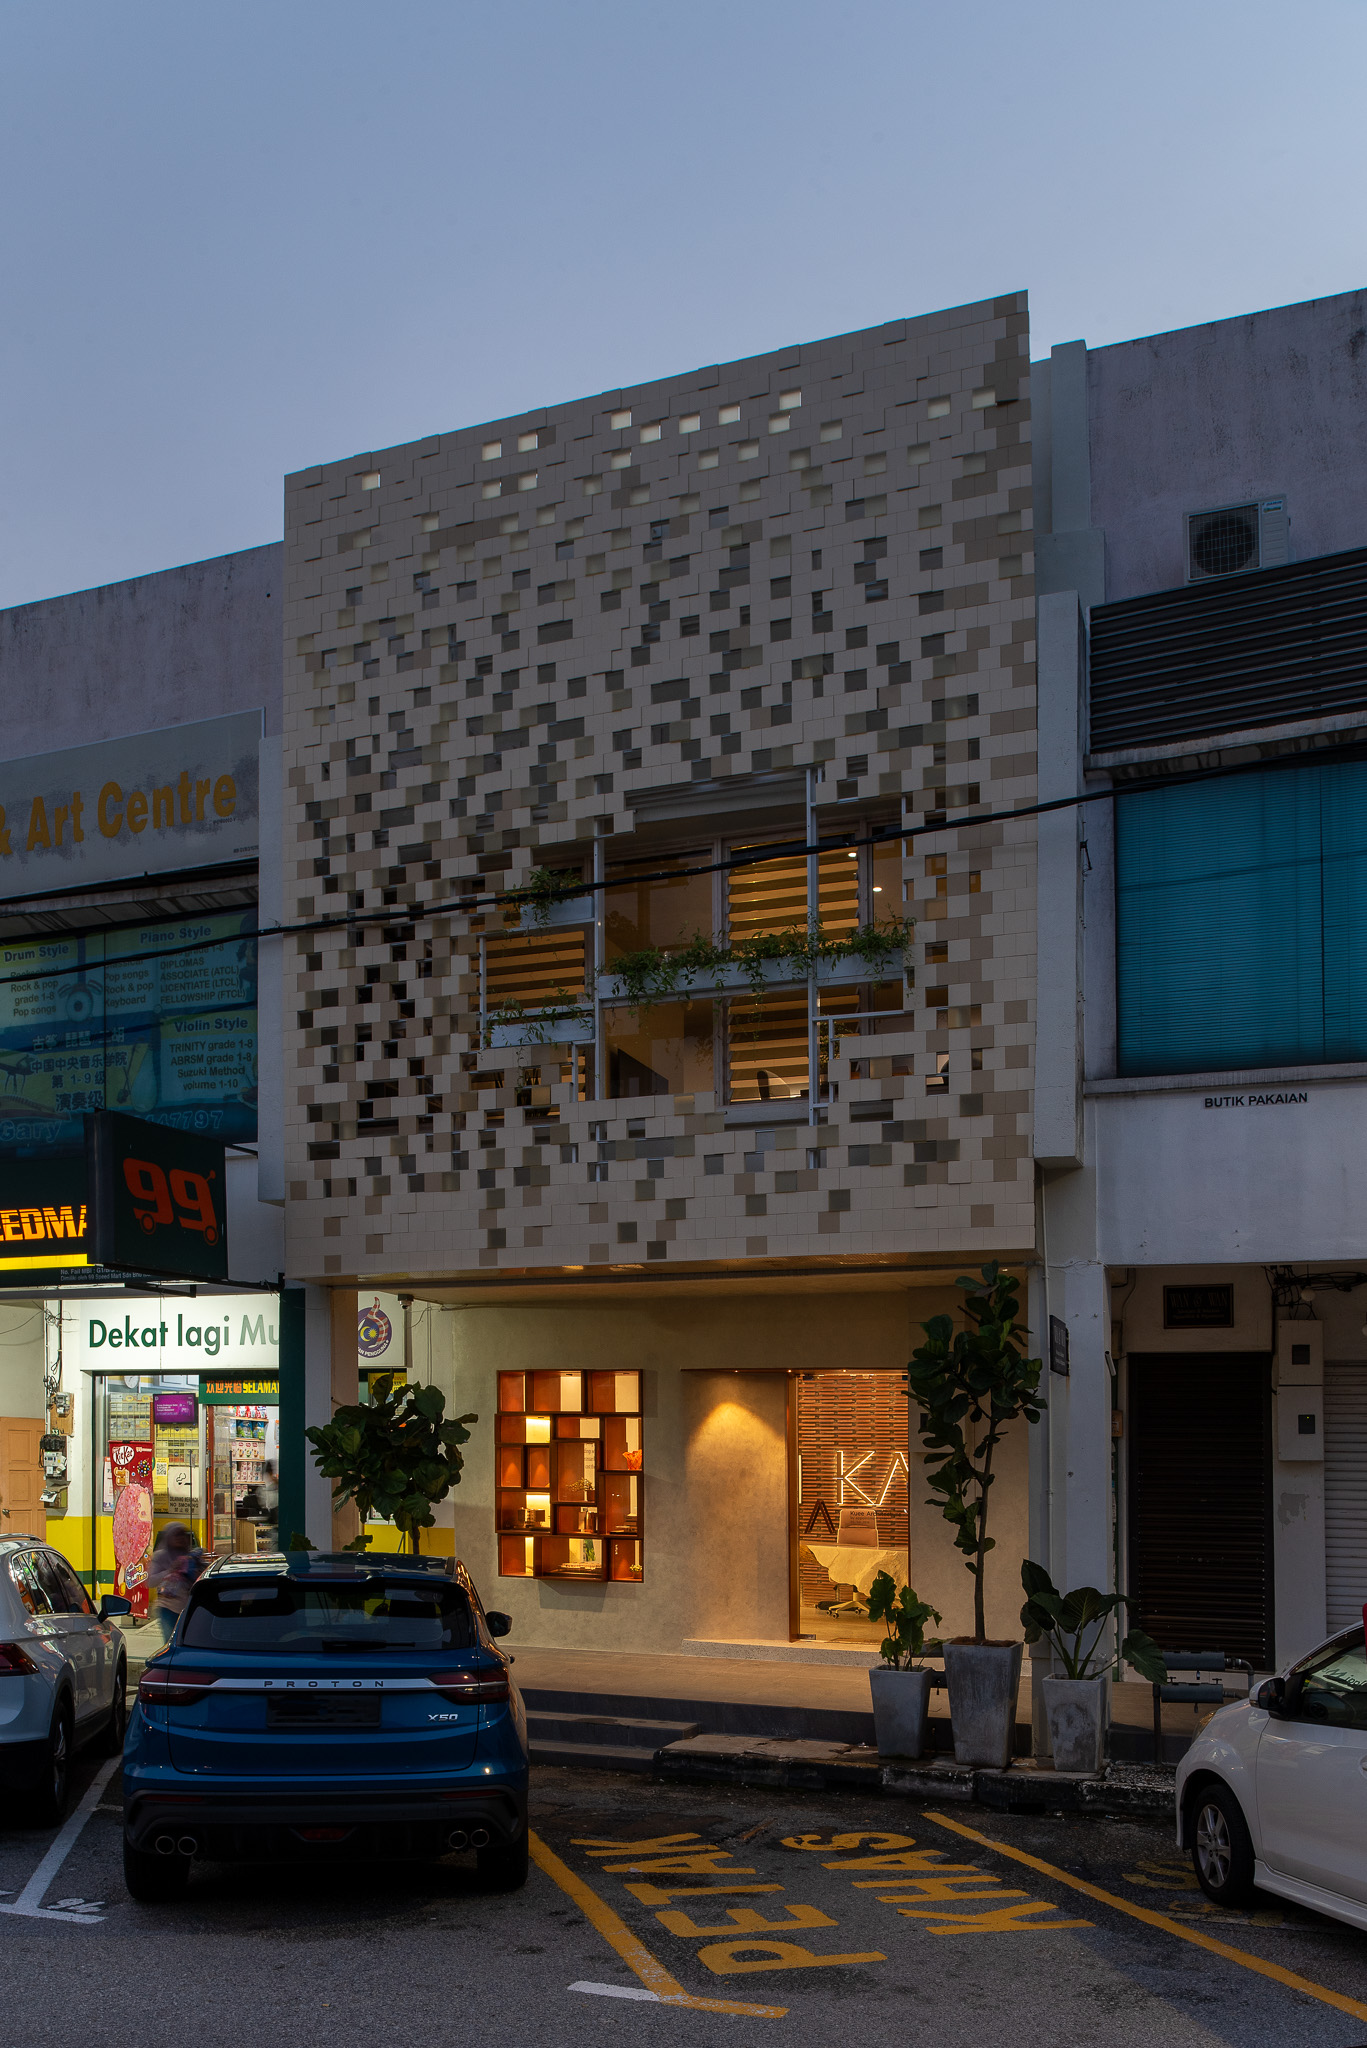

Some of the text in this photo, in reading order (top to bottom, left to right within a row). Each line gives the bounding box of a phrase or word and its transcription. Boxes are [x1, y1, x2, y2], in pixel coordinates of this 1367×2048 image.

[26, 791, 85, 852] Art
[97, 770, 237, 839] Centre
[140, 926, 212, 944] Piano Style
[4, 944, 69, 963] Drum Style
[160, 957, 205, 970] DIPLOMAS
[122, 969, 150, 980] songs
[160, 966, 240, 981] ASSOCIATE (ATCL)
[10, 979, 59, 993] Rock & pop
[128, 983, 135, 992] &
[136, 982, 154, 994] pop
[160, 977, 241, 993] LICENTIATE (LTCL)
[14, 992, 55, 1006] grade 1-8
[105, 995, 146, 1008] Keyboard
[160, 991, 216, 1005] FELLOWSHIP
[13, 1004, 57, 1017] Pop songs
[174, 1017, 249, 1032] Violin Style
[169, 1039, 253, 1053] TRINITY grade 1-8
[31, 1051, 128, 1074] 中国中央音乐学院
[170, 1052, 252, 1066] ABRSM grade 1-8
[177, 1066, 246, 1078] Suzuki Method
[183, 1079, 239, 1091] volume 1-10
[55, 1090, 105, 1113] 演奏级
[1204, 1092, 1309, 1108] BUTIK PAKAIAN
[0, 1119, 63, 1143] Gary
[123, 1157, 218, 1246] 99
[0, 1205, 87, 1242] EDM
[89, 1313, 280, 1356] Dekat lagi Mu
[206, 1380, 243, 1394] 欢迎光临
[263, 1680, 385, 1688] PROTON
[427, 1713, 459, 1722] X50
[780, 1830, 1098, 1936] KHAS
[570, 1832, 889, 1976] PETAK
